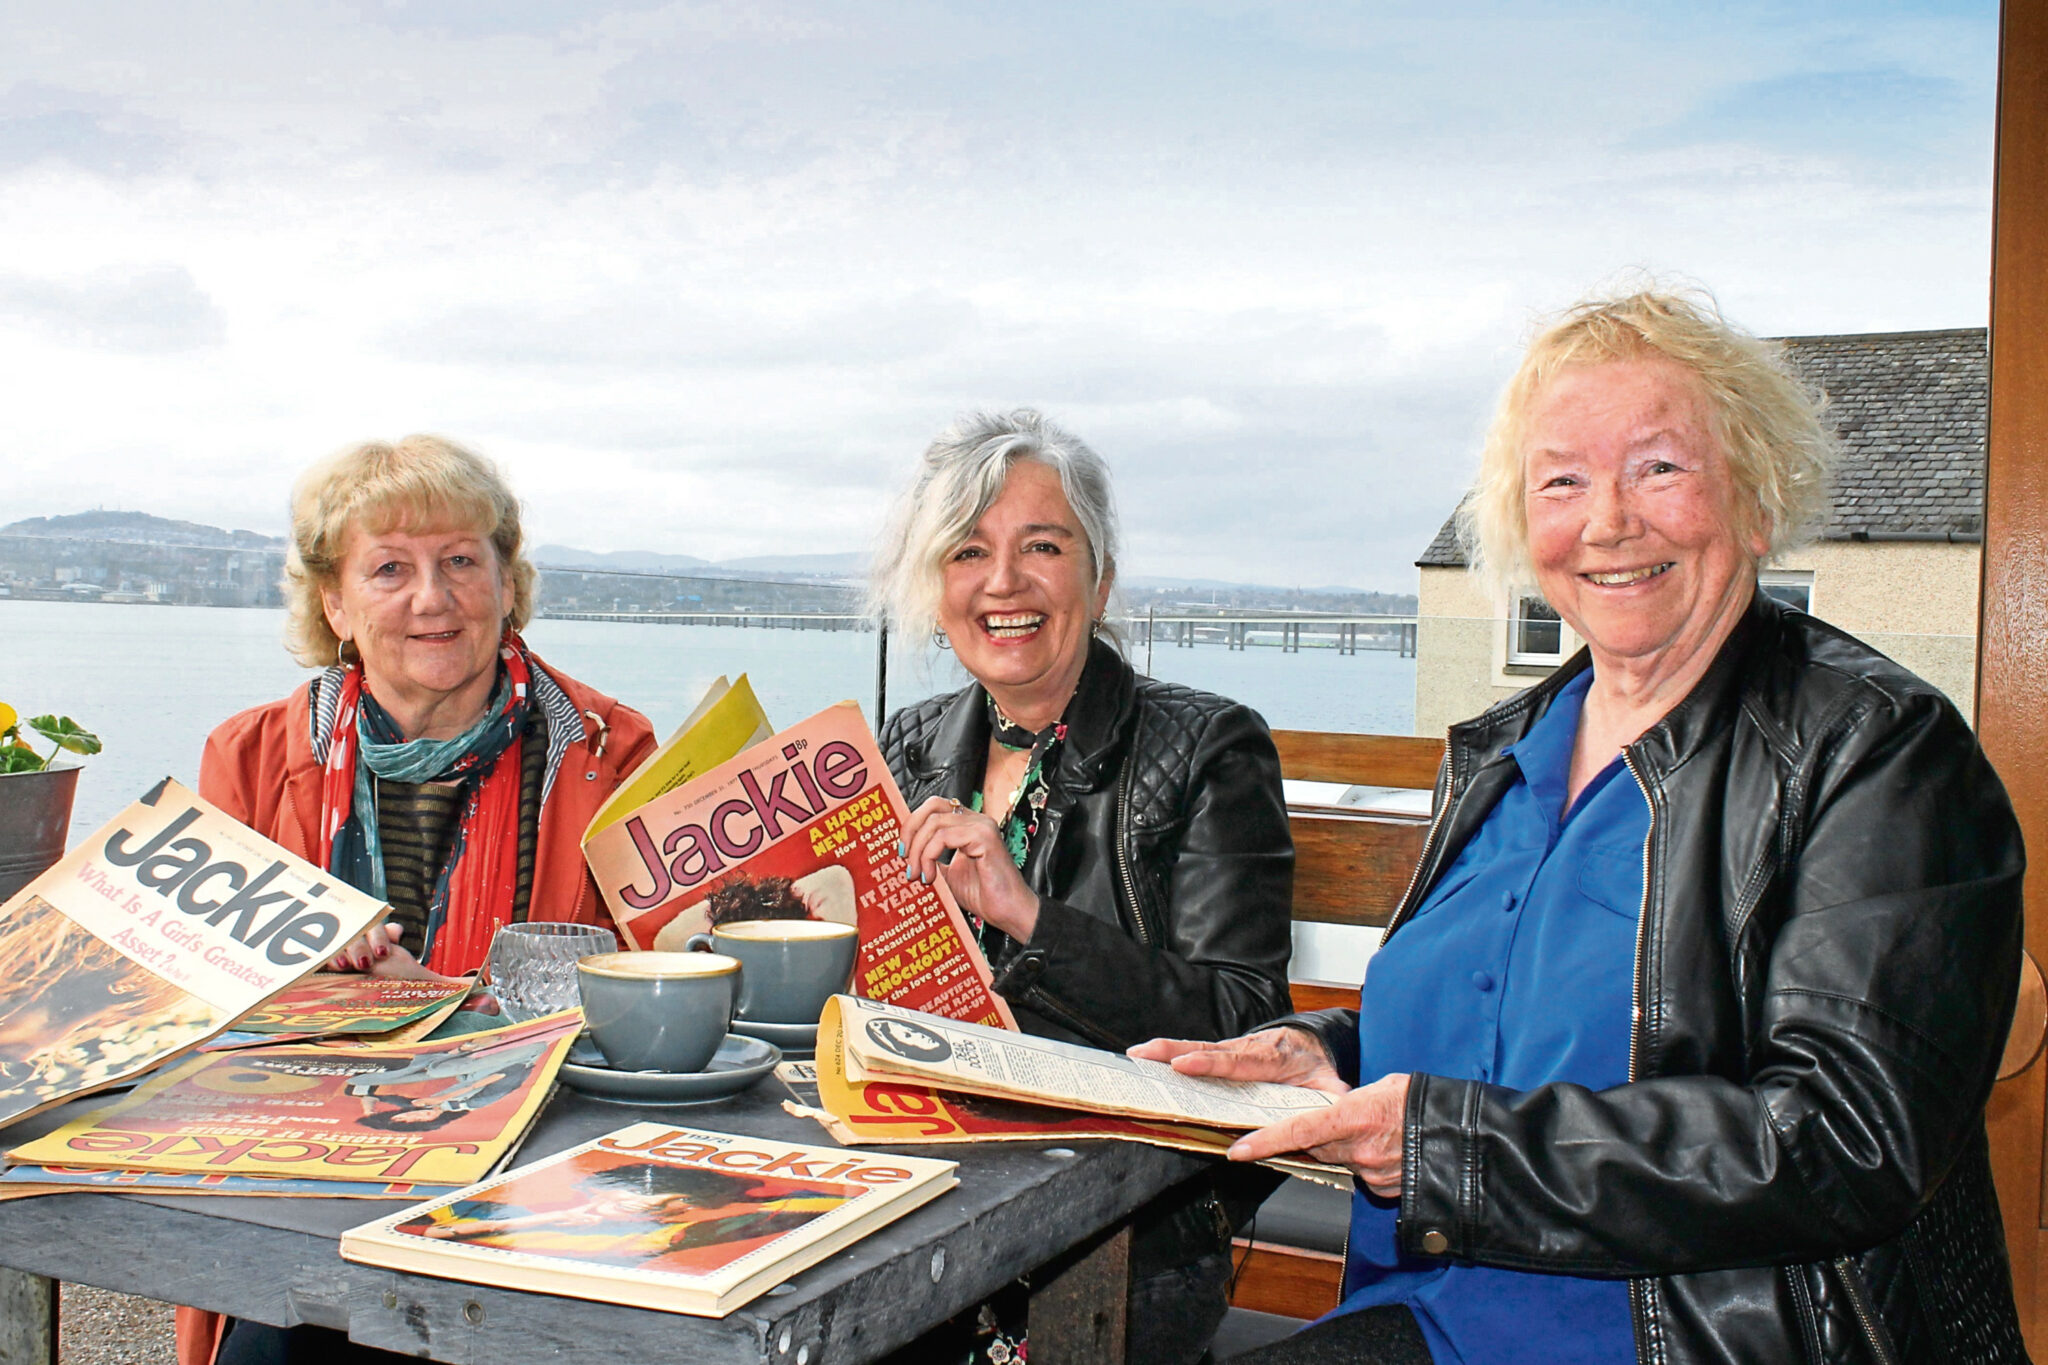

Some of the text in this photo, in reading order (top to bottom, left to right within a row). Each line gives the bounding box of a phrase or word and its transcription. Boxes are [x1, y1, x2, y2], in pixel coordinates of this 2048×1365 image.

[795, 738, 808, 750] 8p
[619, 741, 868, 909] Jackie
[809, 789, 881, 843] A HAPPY
[812, 803, 891, 857] NEW YOU!
[834, 818, 896, 858] How to step
[866, 828, 900, 852] boldly
[868, 848, 889, 865] into
[104, 807, 340, 966] Jackie
[870, 855, 908, 882] TAK
[860, 871, 909, 909] IT FRO
[876, 880, 929, 914] YEAR
[898, 892, 935, 917] Tip top
[77, 860, 125, 903] What
[121, 892, 143, 914] Is
[140, 909, 163, 928] A
[160, 919, 204, 953] Girl's
[203, 945, 276, 990] Greatest
[861, 901, 939, 953] resolutions for
[867, 911, 946, 963] a beautiful you
[111, 926, 165, 965] Asset
[864, 924, 955, 986] NEW YEAR
[866, 937, 961, 1000] KNOCKOUT!
[891, 986, 909, 1001] the
[909, 972, 932, 989] love
[933, 954, 965, 977] game-
[936, 962, 971, 985] to win
[918, 975, 979, 1013] BEAUTIFUL
[950, 995, 987, 1019] PIN-UP
[952, 985, 983, 1008] RATS
[239, 1013, 397, 1030] Jac
[834, 1039, 842, 1053] DEC
[67, 1131, 478, 1176] Jackie
[177, 1126, 423, 1145] ALLSORTS OF GOODIES
[688, 1133, 733, 1144] 1978
[598, 1131, 912, 1184] Jackie
